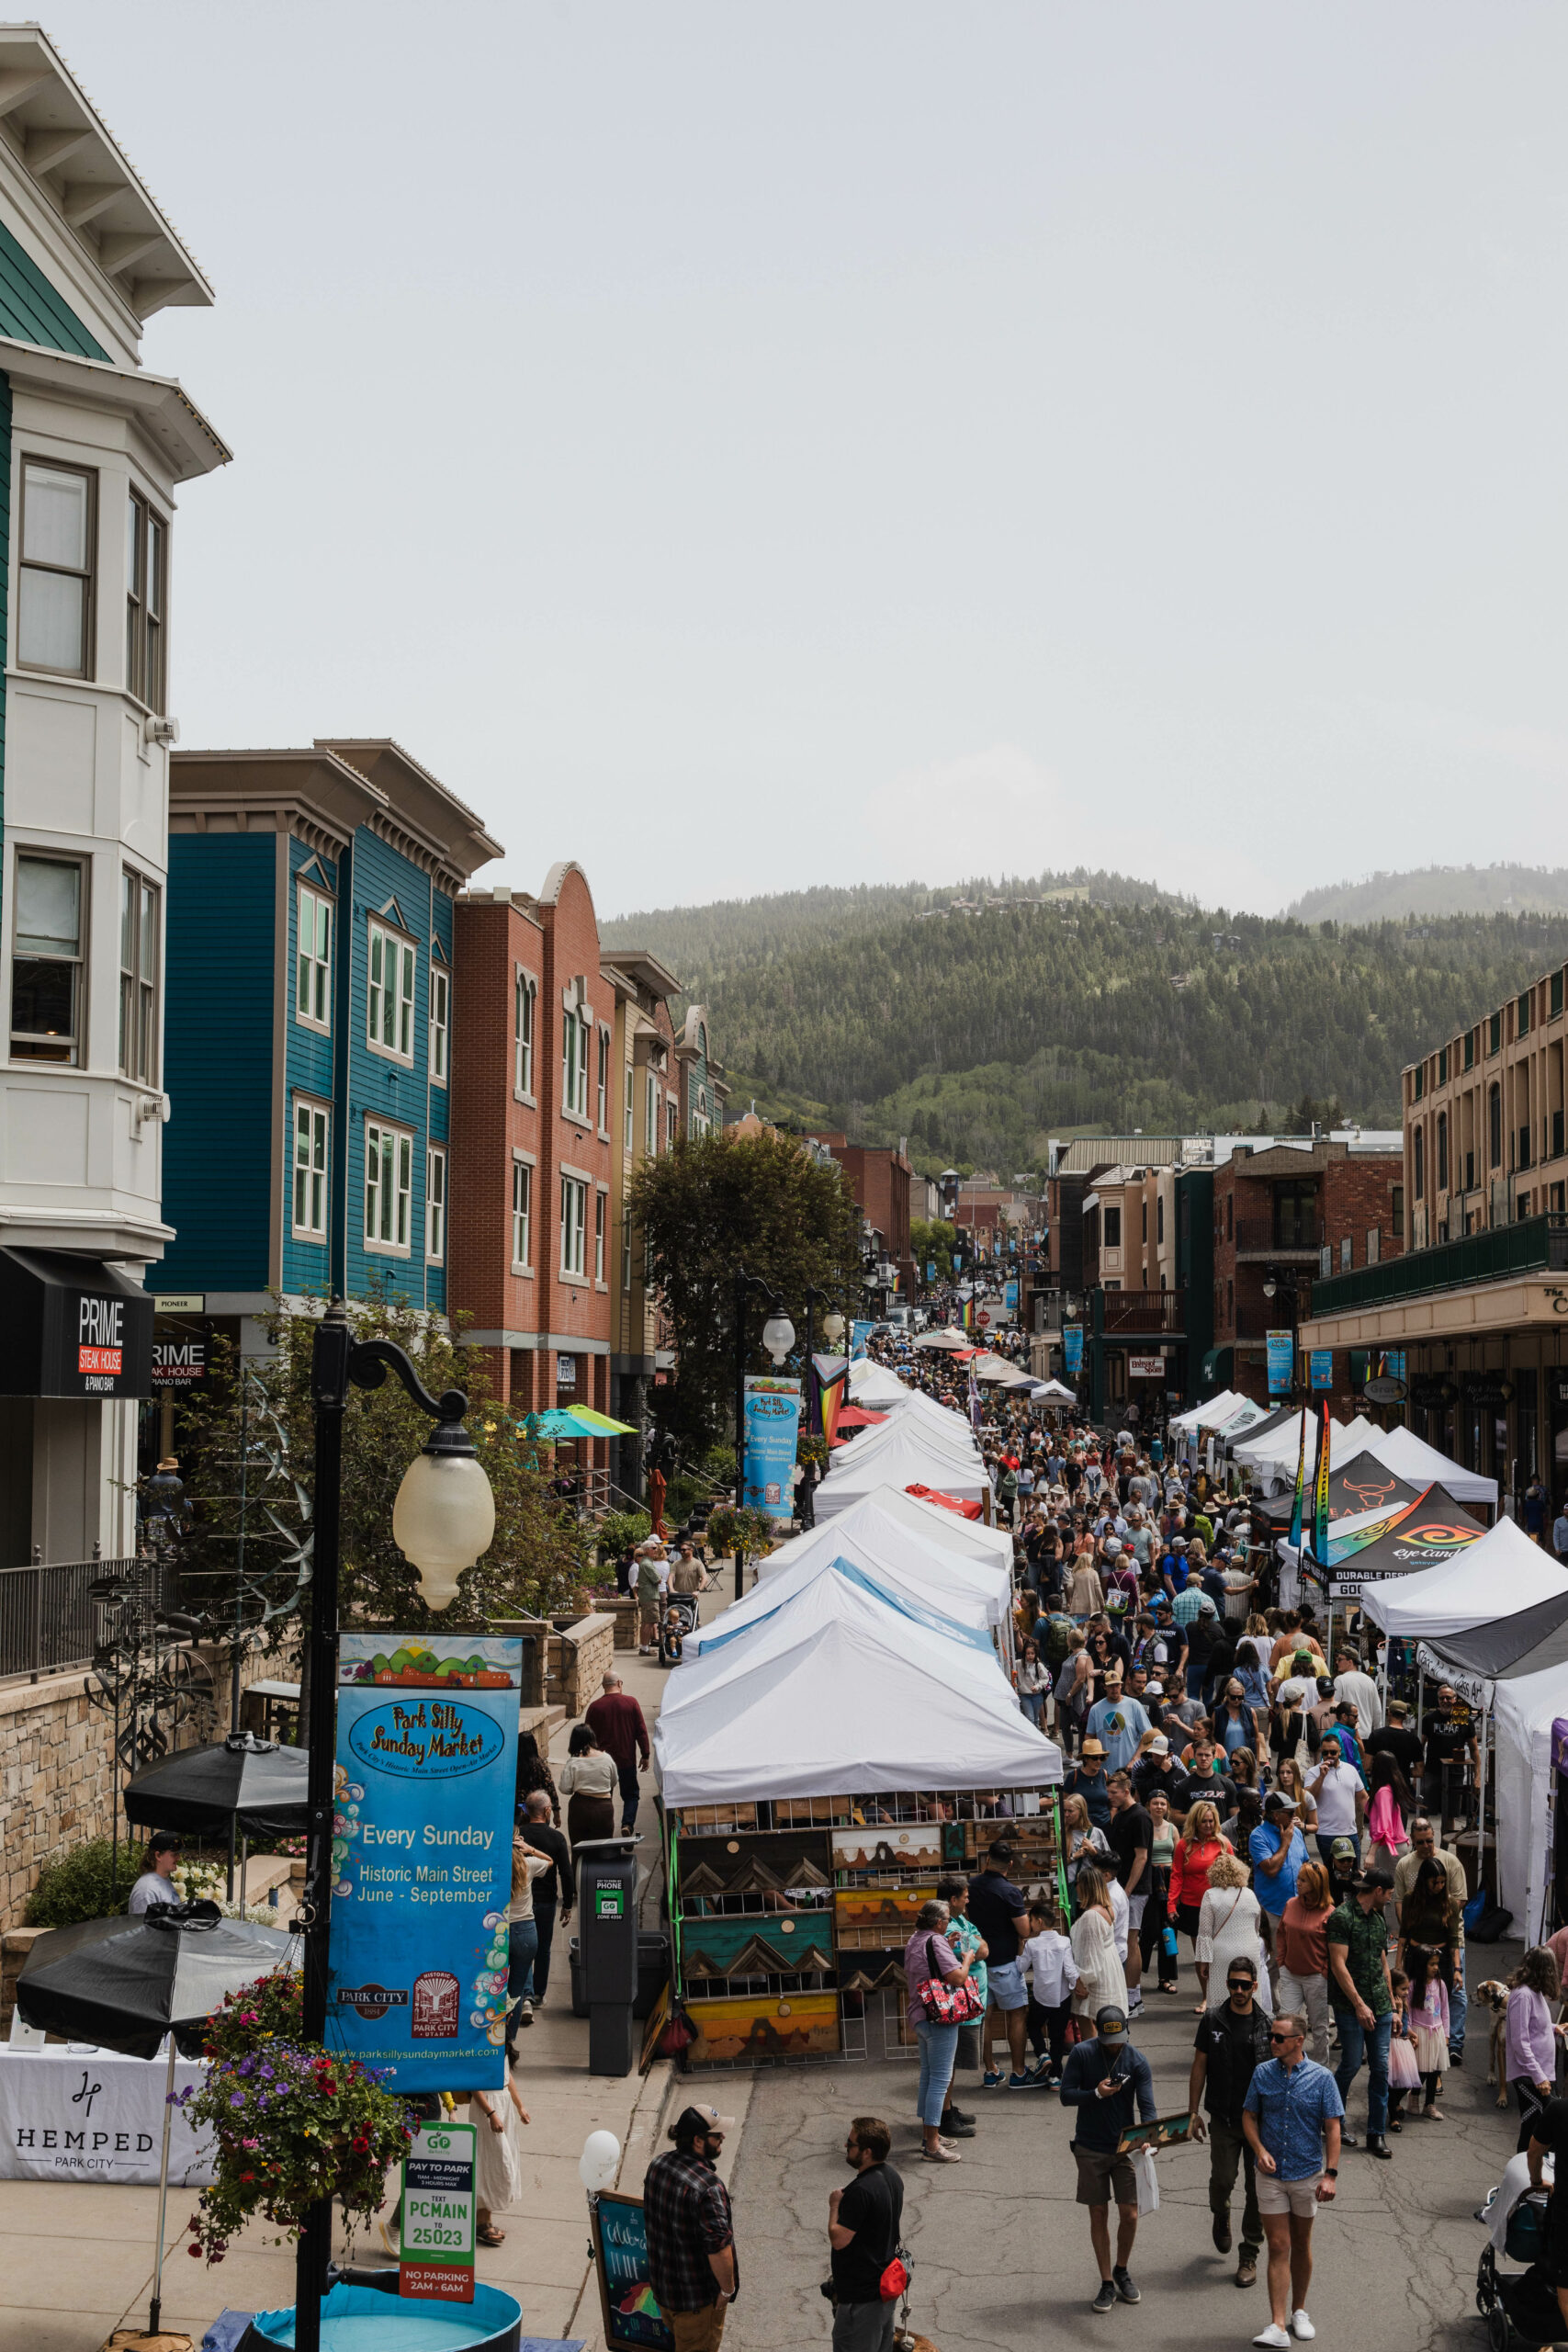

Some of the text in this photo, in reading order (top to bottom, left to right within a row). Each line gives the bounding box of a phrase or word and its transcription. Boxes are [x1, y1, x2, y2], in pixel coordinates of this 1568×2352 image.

[1544, 1286, 1563, 1296] The
[79, 1296, 124, 1347] PRIME
[80, 1350, 121, 1371] STEAK HOUSE
[152, 1345, 205, 1365] RIME
[167, 1367, 202, 1376] HOUSE
[85, 1376, 114, 1392] & PIANO BAR
[750, 1435, 793, 1445] Every Sunday
[1393, 1547, 1462, 1560] eye Cand
[1336, 1571, 1382, 1580] DURABLE
[392, 1702, 463, 1739] Park Silly
[369, 1725, 484, 1767] Sunday Market
[356, 1741, 367, 1755] Park
[367, 1752, 385, 1766] City's
[385, 1761, 410, 1772] Historic
[479, 1744, 498, 1761] Market
[363, 1824, 494, 1851] Every Sunday
[359, 1865, 493, 1883] Historic Main Street
[357, 1886, 394, 1903] June
[410, 1886, 492, 1905] September
[341, 1991, 405, 2003] PARK CITY
[364, 2007, 381, 2016] 1884
[437, 2023, 457, 2031] CITY
[331, 2047, 499, 2061] www.parksillysundaymarket.com
[17, 2128, 153, 2153] HEMPED
[55, 2156, 114, 2169] PARK CITY
[409, 2162, 470, 2174] PAY TO PARK
[410, 2200, 468, 2220] PCMAIN
[412, 2228, 463, 2246] 25023
[405, 2270, 469, 2283] NO PARKING
[411, 2281, 434, 2290] 2AM
[441, 2283, 464, 2293] 6AM
